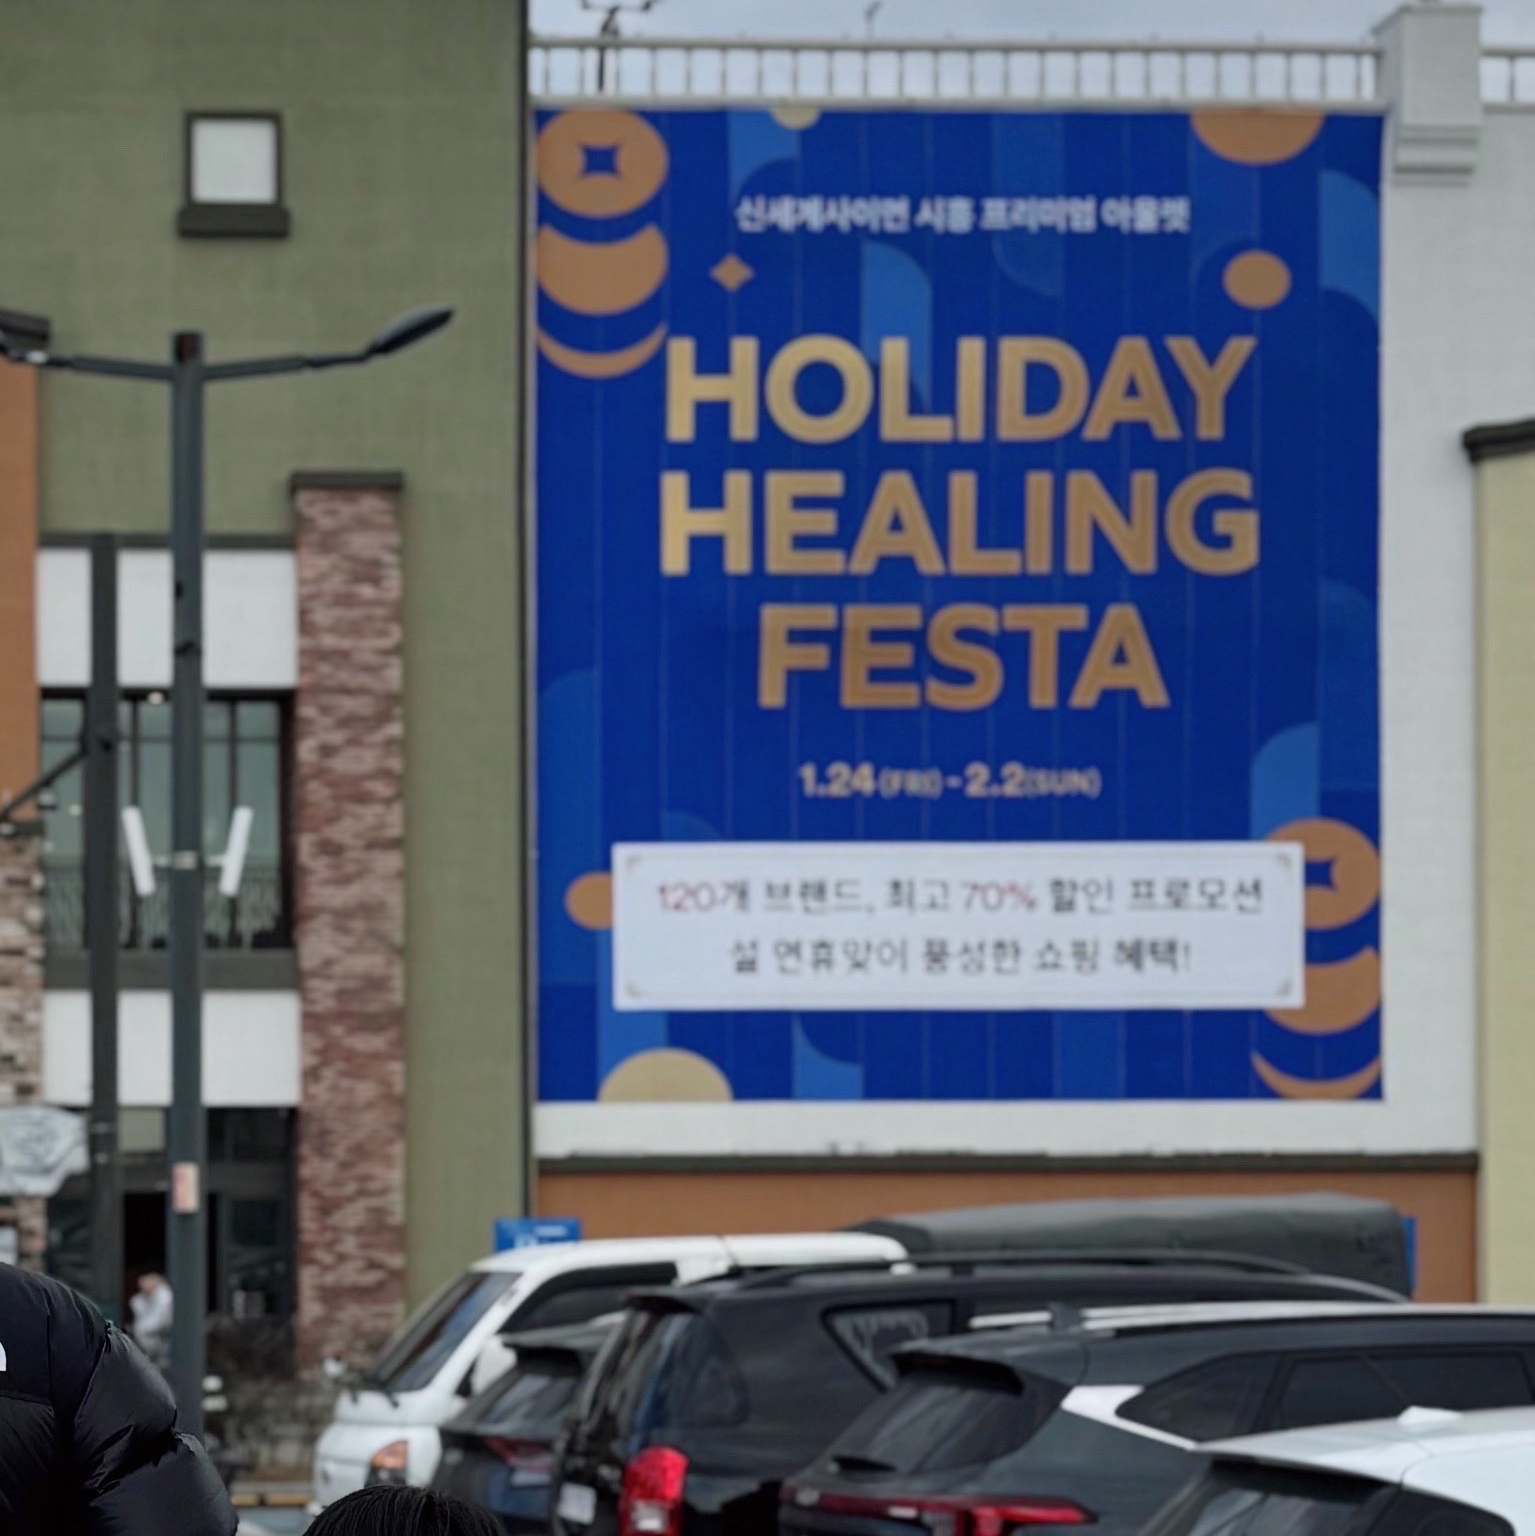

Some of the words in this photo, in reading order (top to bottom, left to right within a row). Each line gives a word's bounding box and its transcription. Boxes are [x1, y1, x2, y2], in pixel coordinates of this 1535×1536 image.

[980, 193, 1098, 234] 프리미엄
[1100, 193, 1191, 234] 아울렛
[667, 335, 1256, 442] HOLIDAY
[660, 469, 1260, 576] HEALING
[758, 604, 1169, 709] FESTA
[658, 877, 749, 912] 120개
[888, 877, 949, 911] 최고
[961, 879, 1037, 912] 70%
[1049, 877, 1114, 914] 할인
[1128, 877, 1262, 914] 프로모션
[732, 938, 758, 973] 설
[773, 937, 907, 974] 연휴맞이
[923, 937, 1022, 974] 풍성한
[1034, 937, 1099, 974] 쇼핑
[1114, 937, 1191, 973] 혜택!
